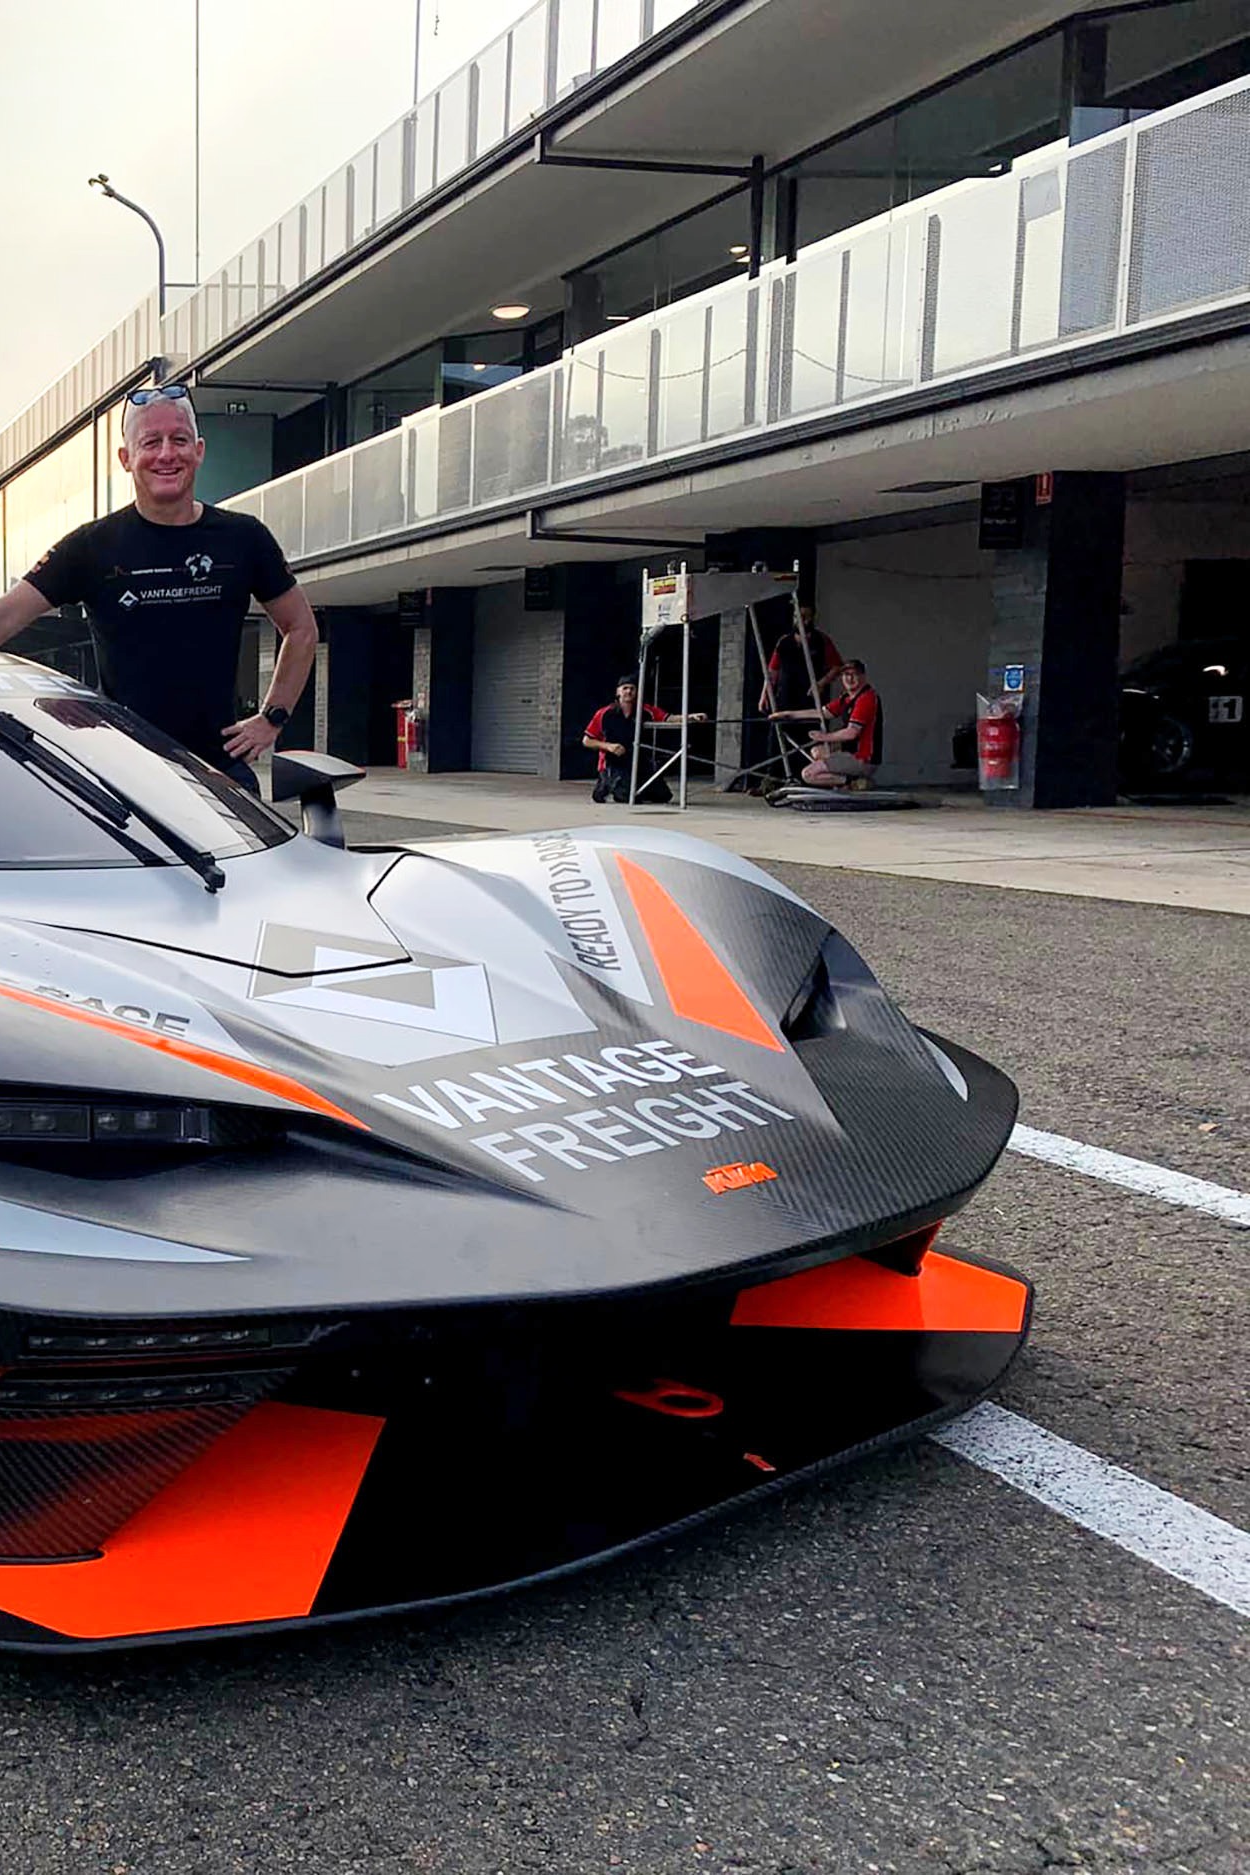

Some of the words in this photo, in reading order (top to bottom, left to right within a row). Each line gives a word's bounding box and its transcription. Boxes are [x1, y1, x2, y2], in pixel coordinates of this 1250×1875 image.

[549, 879, 595, 904] TO
[556, 908, 622, 971] READY
[373, 1039, 726, 1131] VANTAGE
[471, 1081, 796, 1182] FREIGHT
[702, 1161, 778, 1195] KTM
